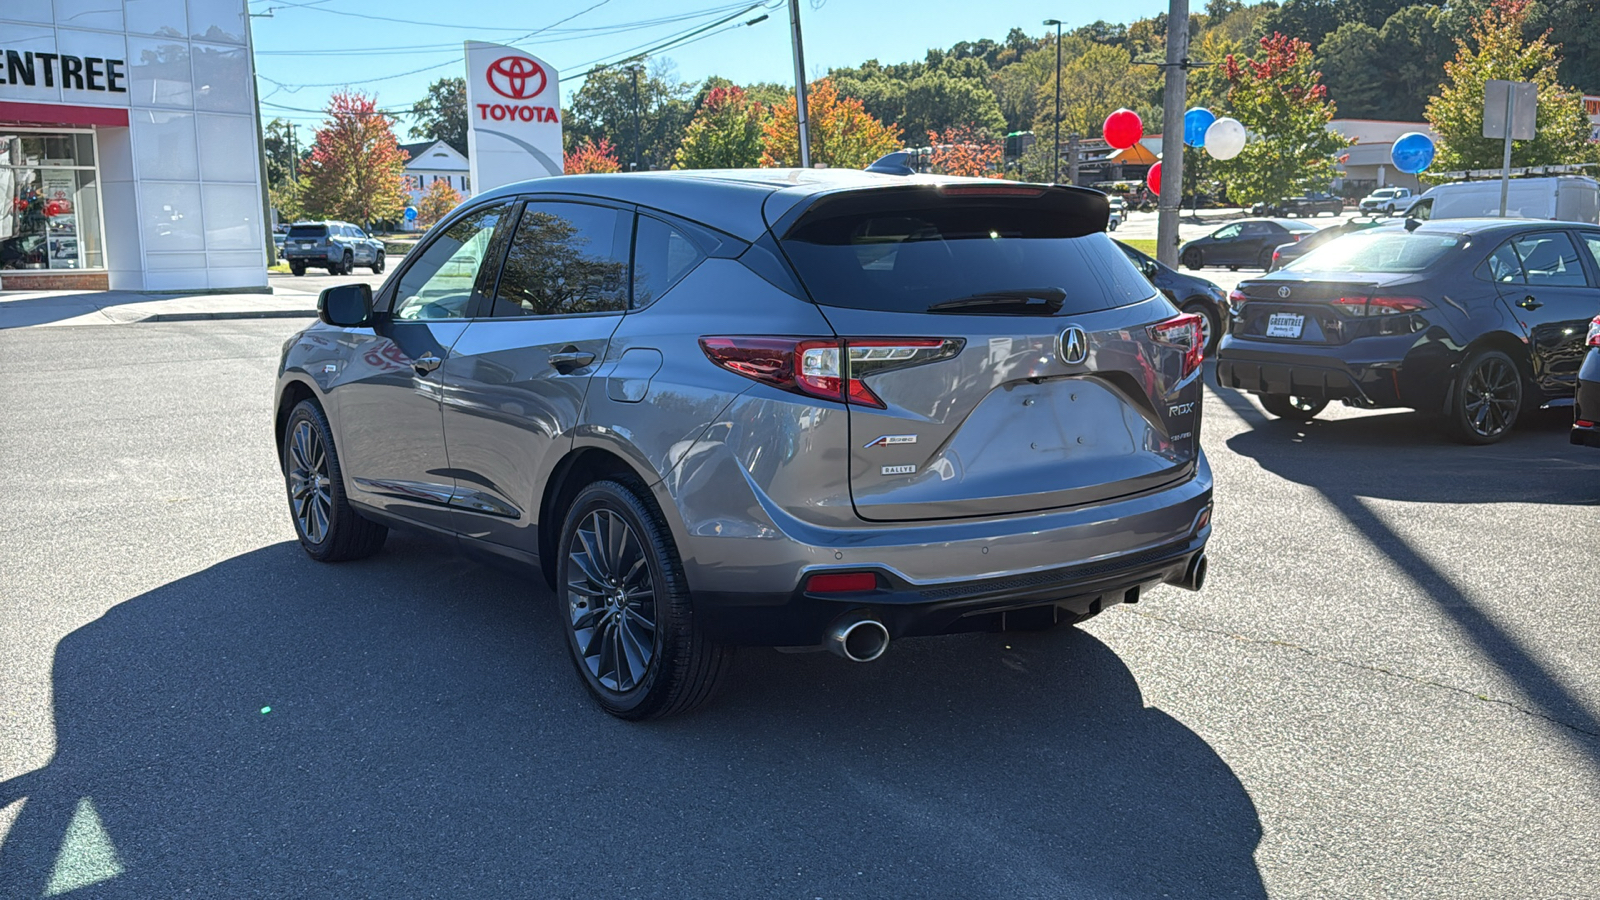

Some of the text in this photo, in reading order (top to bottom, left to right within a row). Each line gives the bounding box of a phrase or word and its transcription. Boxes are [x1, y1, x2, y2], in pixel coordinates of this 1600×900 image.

[476, 103, 559, 124] TOYOTA
[1270, 317, 1302, 327] GREENTREE
[1169, 402, 1195, 417] RDX
